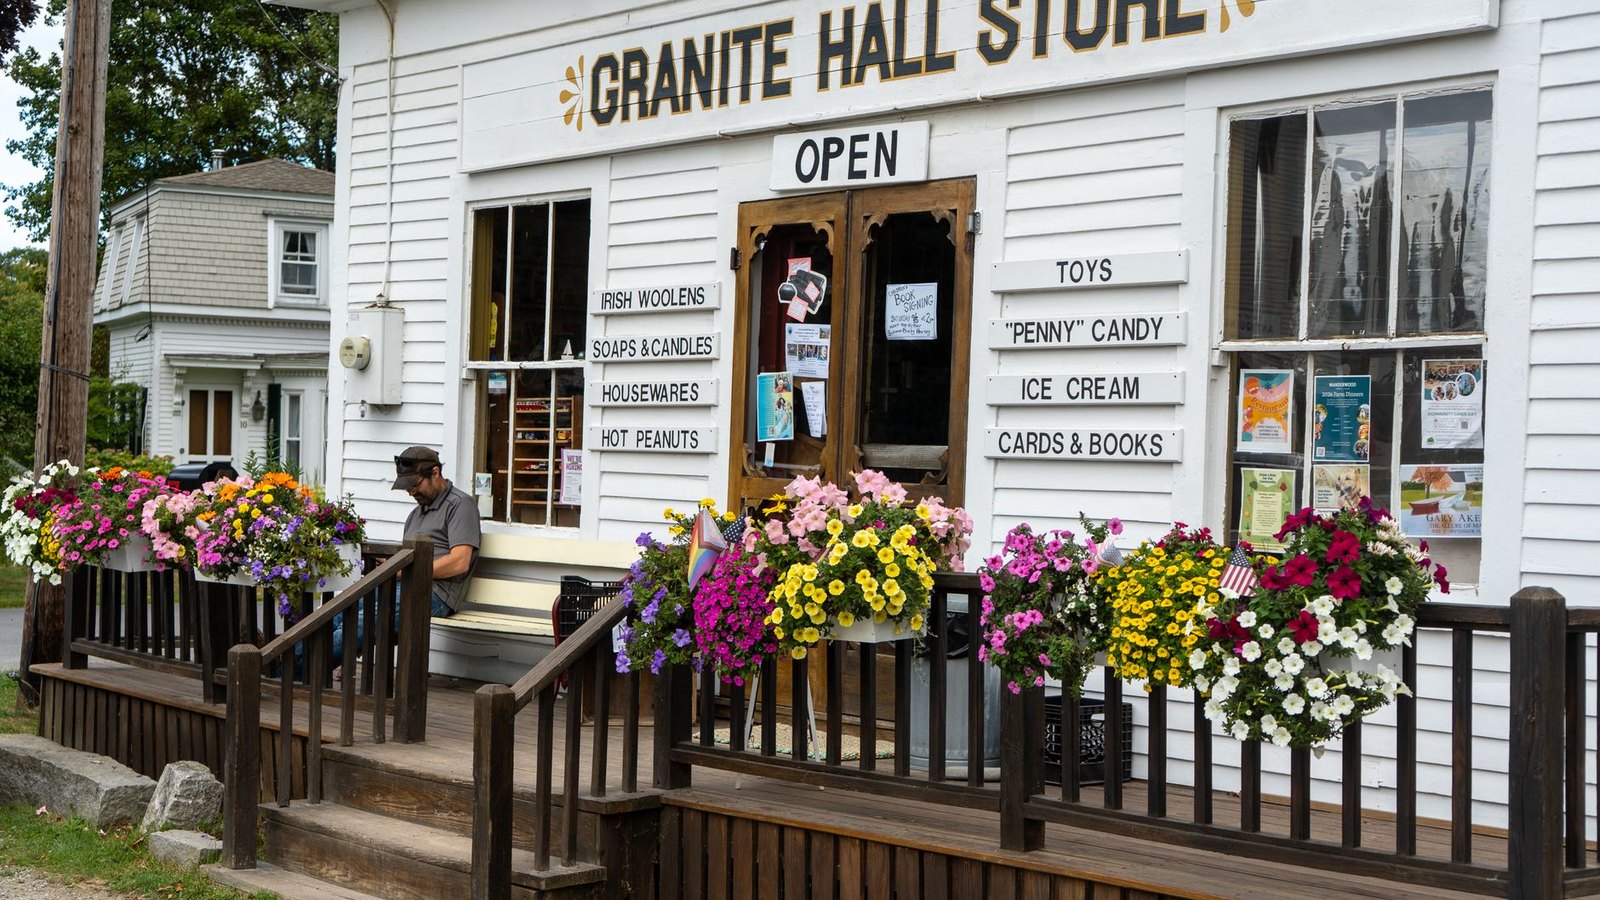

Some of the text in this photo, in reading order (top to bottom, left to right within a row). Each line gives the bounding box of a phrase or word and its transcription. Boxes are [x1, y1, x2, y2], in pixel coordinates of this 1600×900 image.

[589, 17, 794, 127] GRANITE
[817, 0, 956, 92] HALL
[795, 129, 898, 184] OPEN
[1056, 258, 1112, 283] TOYS
[601, 286, 705, 310] IRISH WOOLENS
[894, 289, 916, 306] BOOK
[903, 294, 934, 313] SIGNING
[1005, 317, 1163, 344] "PENNY" CANDY
[592, 336, 712, 358] SOAPS & CANDLES
[602, 383, 699, 402] HOUSEWARES
[1022, 377, 1140, 400] ICE CREAM
[601, 429, 699, 449] HOT PEANUTS
[998, 432, 1163, 457] CARDS & BOOKS
